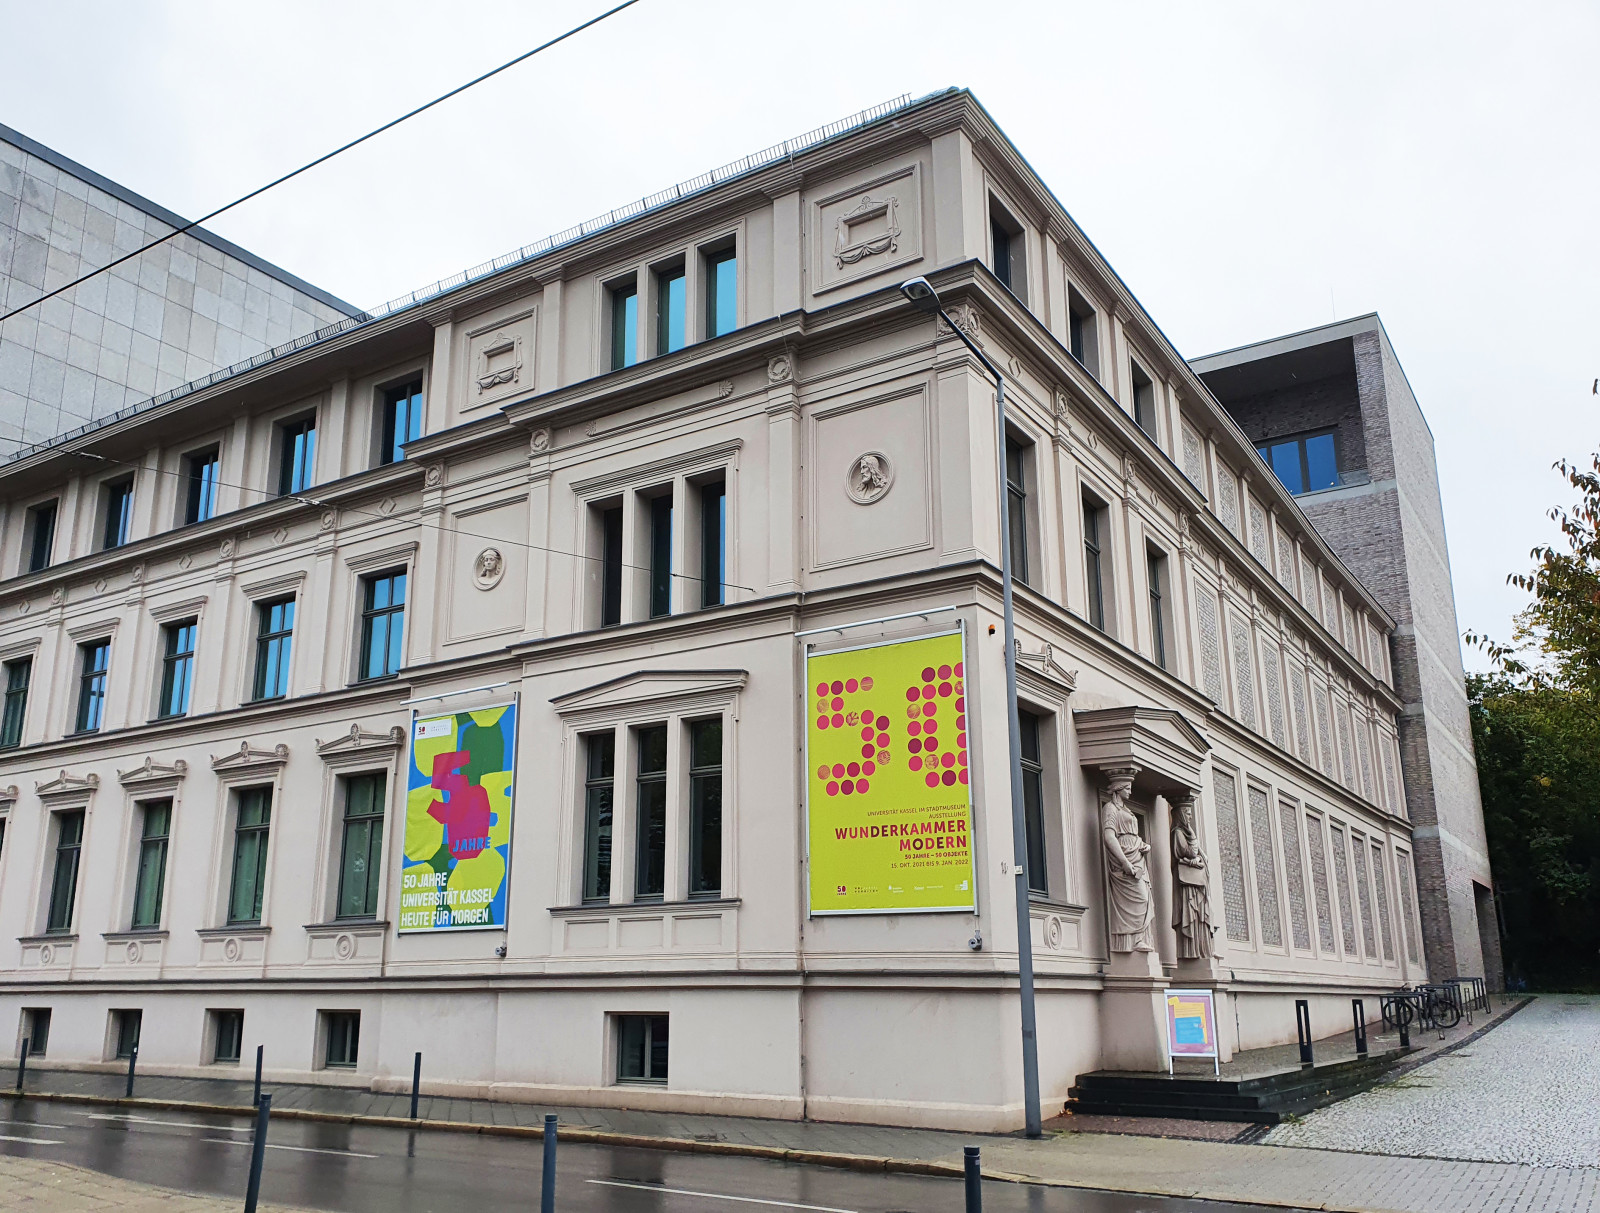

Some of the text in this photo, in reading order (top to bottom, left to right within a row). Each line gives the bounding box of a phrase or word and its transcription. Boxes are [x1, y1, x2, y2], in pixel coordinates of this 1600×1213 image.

[867, 809, 898, 817] UNIVERSITÄT
[926, 804, 966, 812] STADTMUSEUM
[928, 811, 966, 819] AUSSTELLUNG
[835, 820, 966, 840] WUNDERKAMMER
[452, 836, 492, 852] JAHRE
[900, 835, 967, 852] MODERN
[403, 872, 447, 888] 50 JAHRE
[402, 888, 494, 907] UNIVERSITÄT KASSEL
[401, 908, 489, 926] HEUTE FÜR MORGEN
